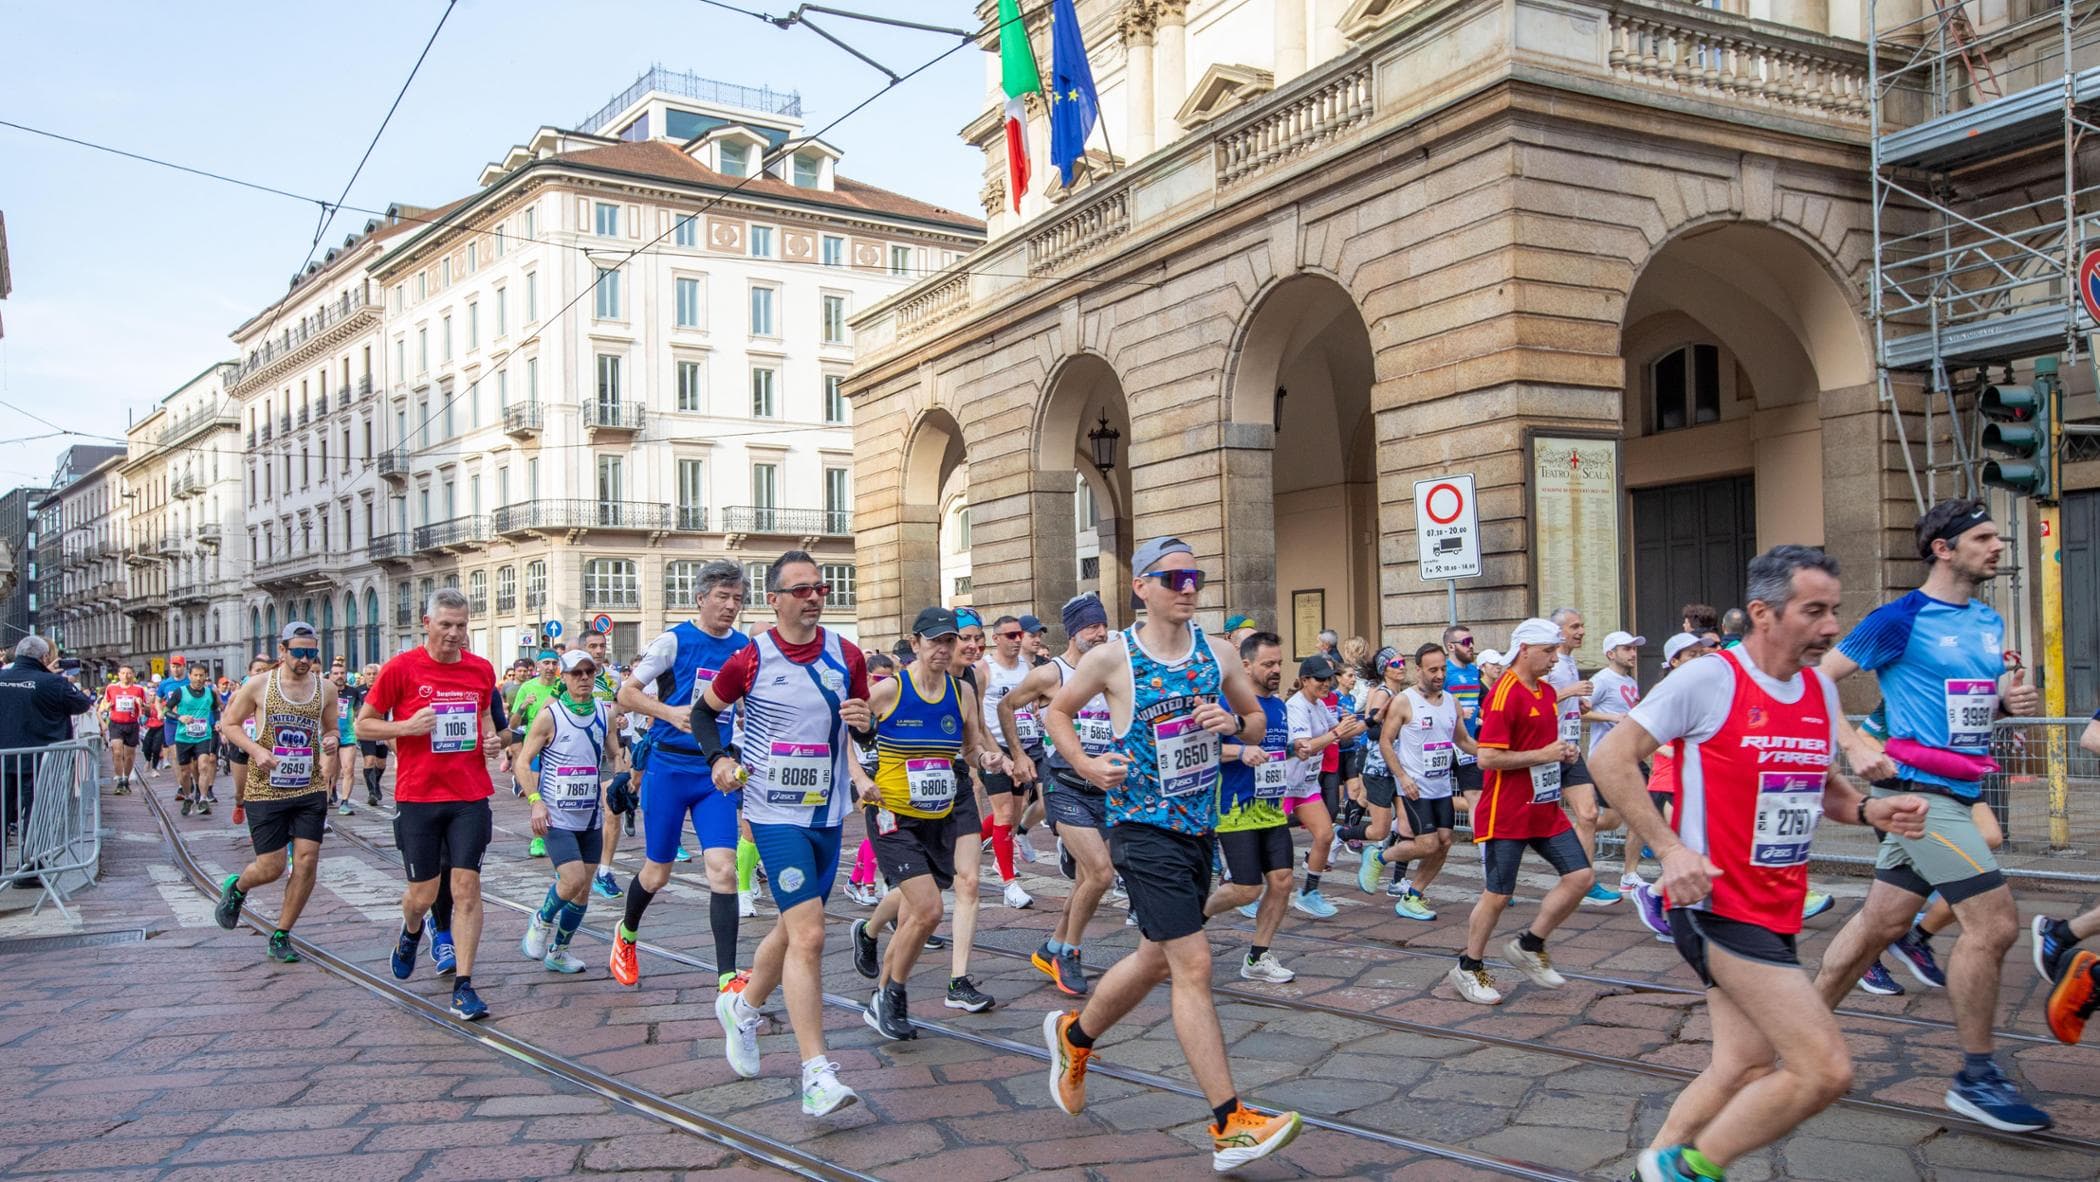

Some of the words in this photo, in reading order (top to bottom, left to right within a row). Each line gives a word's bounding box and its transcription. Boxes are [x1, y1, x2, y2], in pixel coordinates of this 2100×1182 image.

[1583, 467, 1610, 480] SCALA
[1141, 698, 1183, 720] UNITED
[445, 722, 467, 737] 1106
[1740, 736, 1828, 751] RUNNER
[1174, 743, 1208, 770] 2650
[281, 762, 305, 775] 2649
[782, 767, 817, 786] 8086
[567, 783, 589, 796] 7867
[921, 779, 948, 796] 6806
